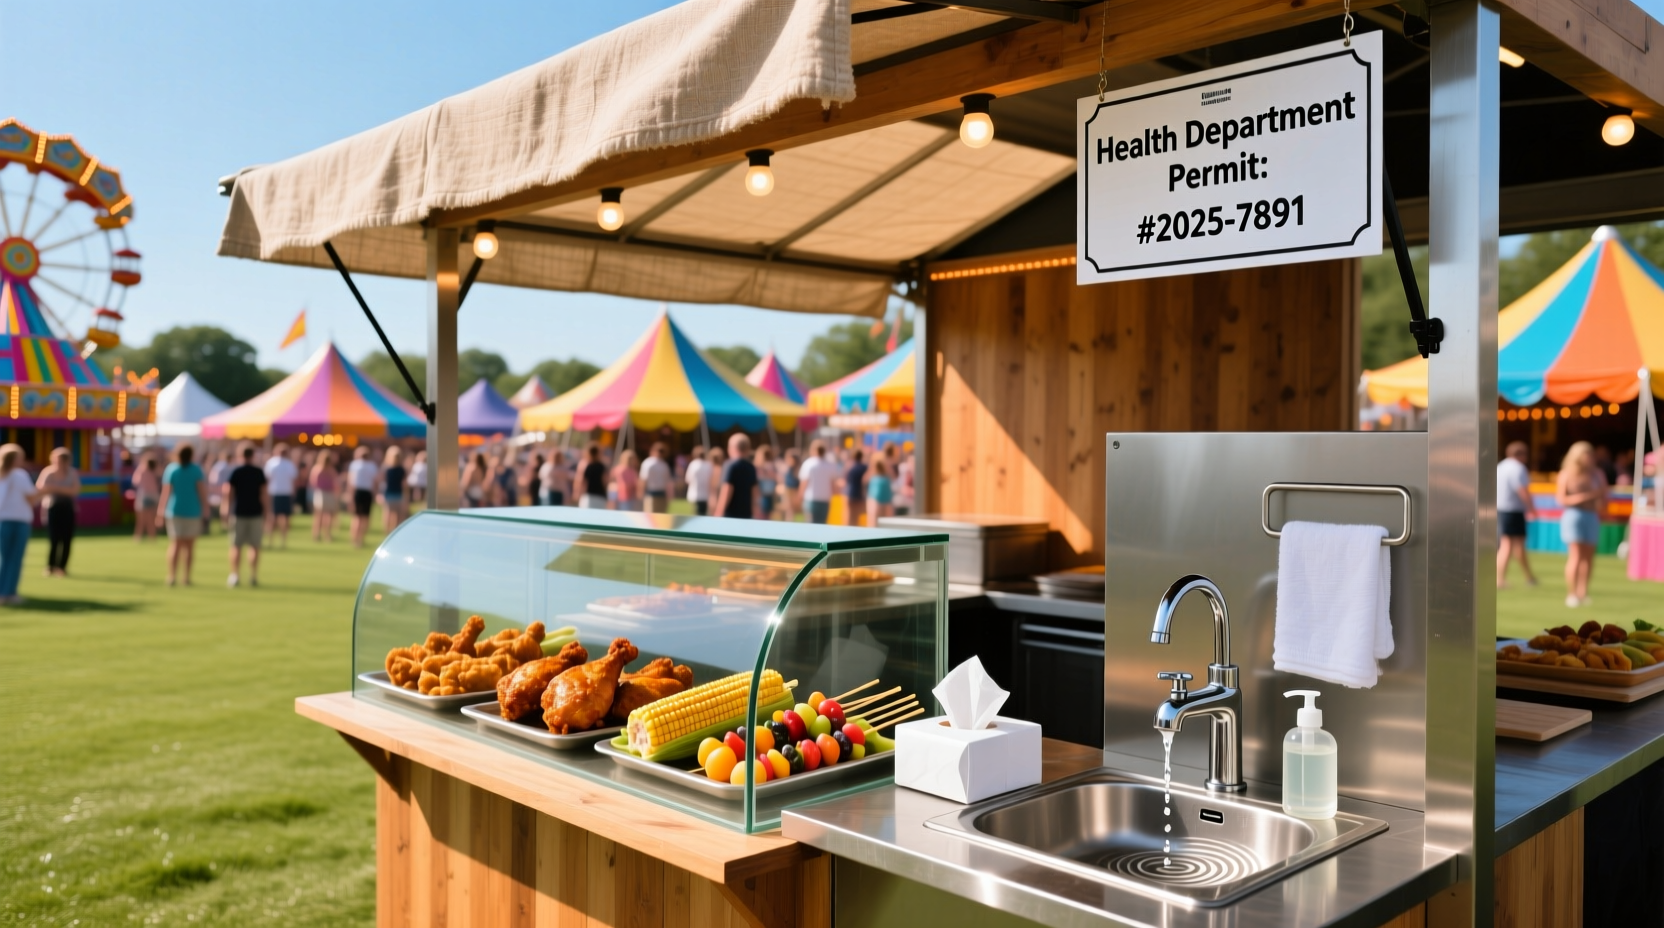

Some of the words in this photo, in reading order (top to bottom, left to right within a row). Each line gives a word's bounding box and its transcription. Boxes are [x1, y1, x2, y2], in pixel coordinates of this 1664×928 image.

[1097, 124, 1178, 165] Health
[1185, 91, 1357, 149] Department
[1168, 151, 1269, 193] Permit:
[1136, 194, 1305, 245] #2025-7891
